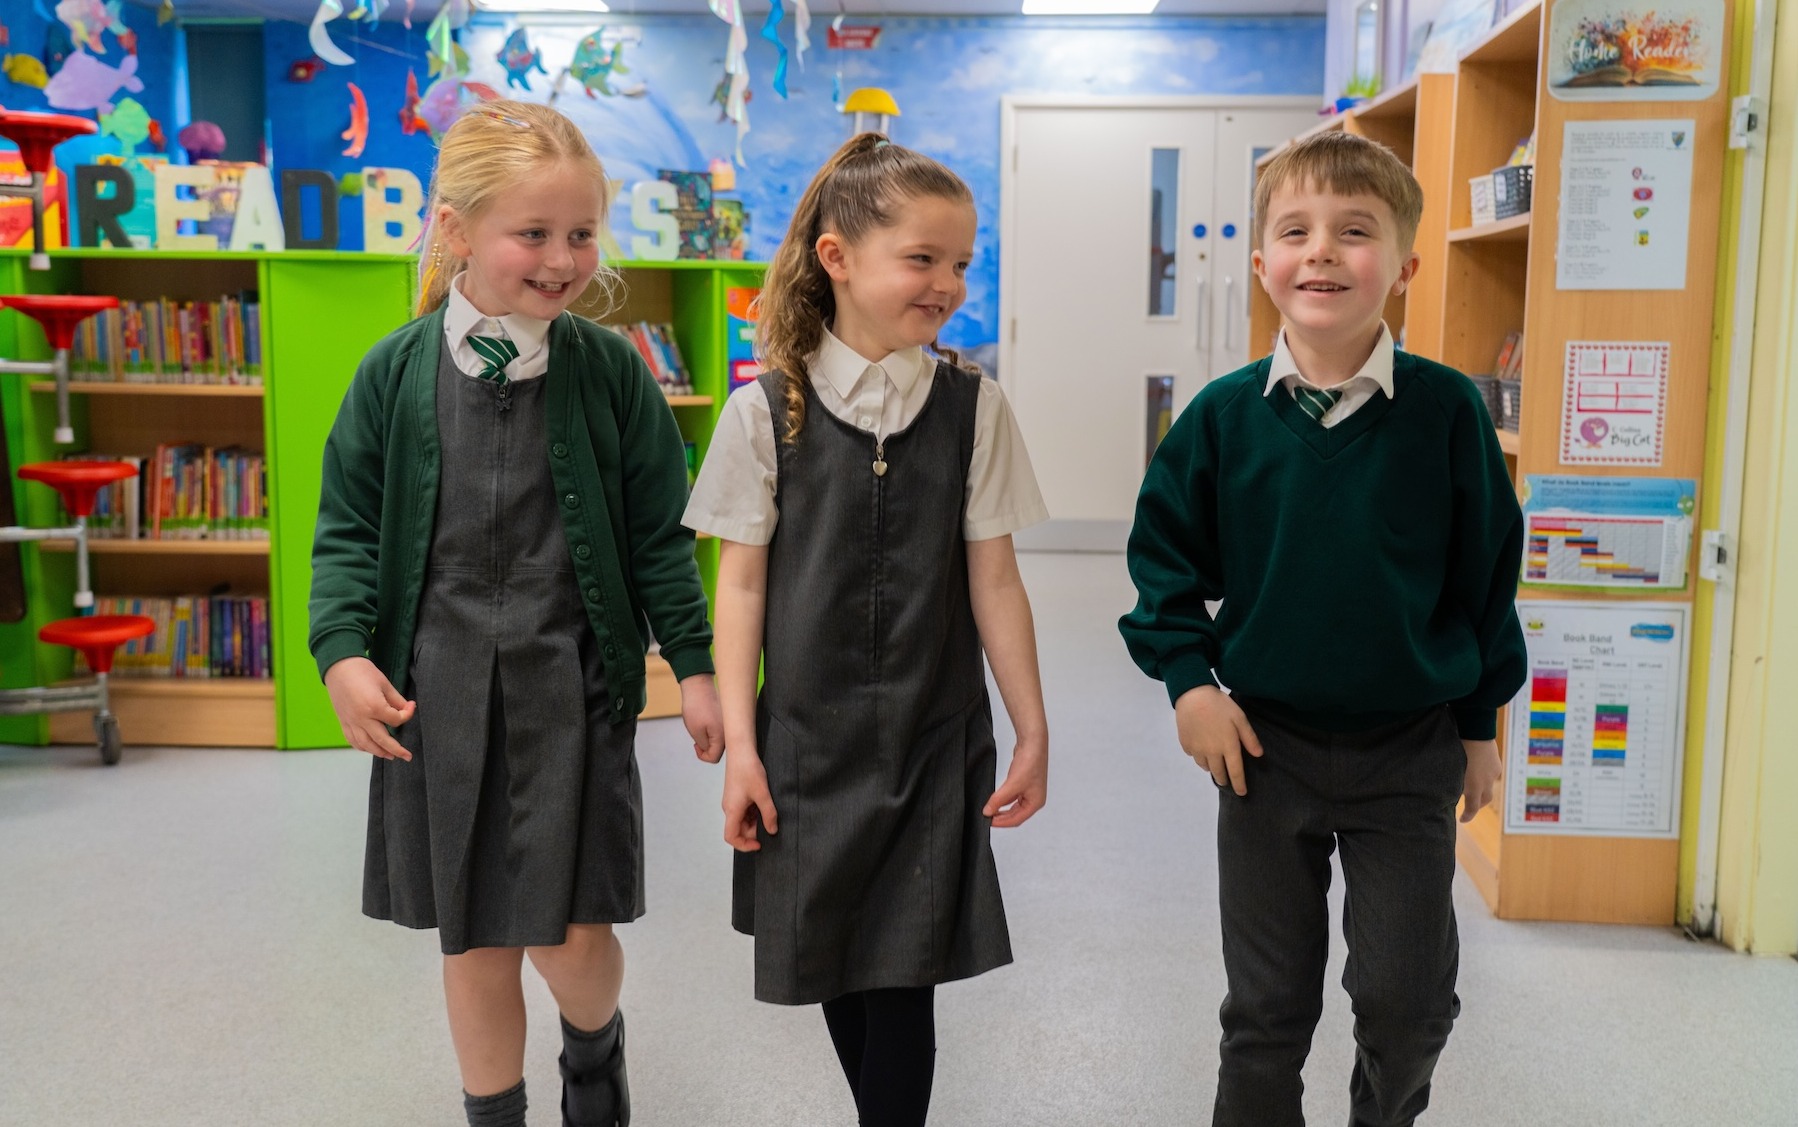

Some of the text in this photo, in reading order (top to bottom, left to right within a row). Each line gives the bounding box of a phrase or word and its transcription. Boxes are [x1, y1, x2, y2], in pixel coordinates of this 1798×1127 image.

[1563, 633, 1612, 644] Book Band
[1590, 645, 1615, 656] Chart
